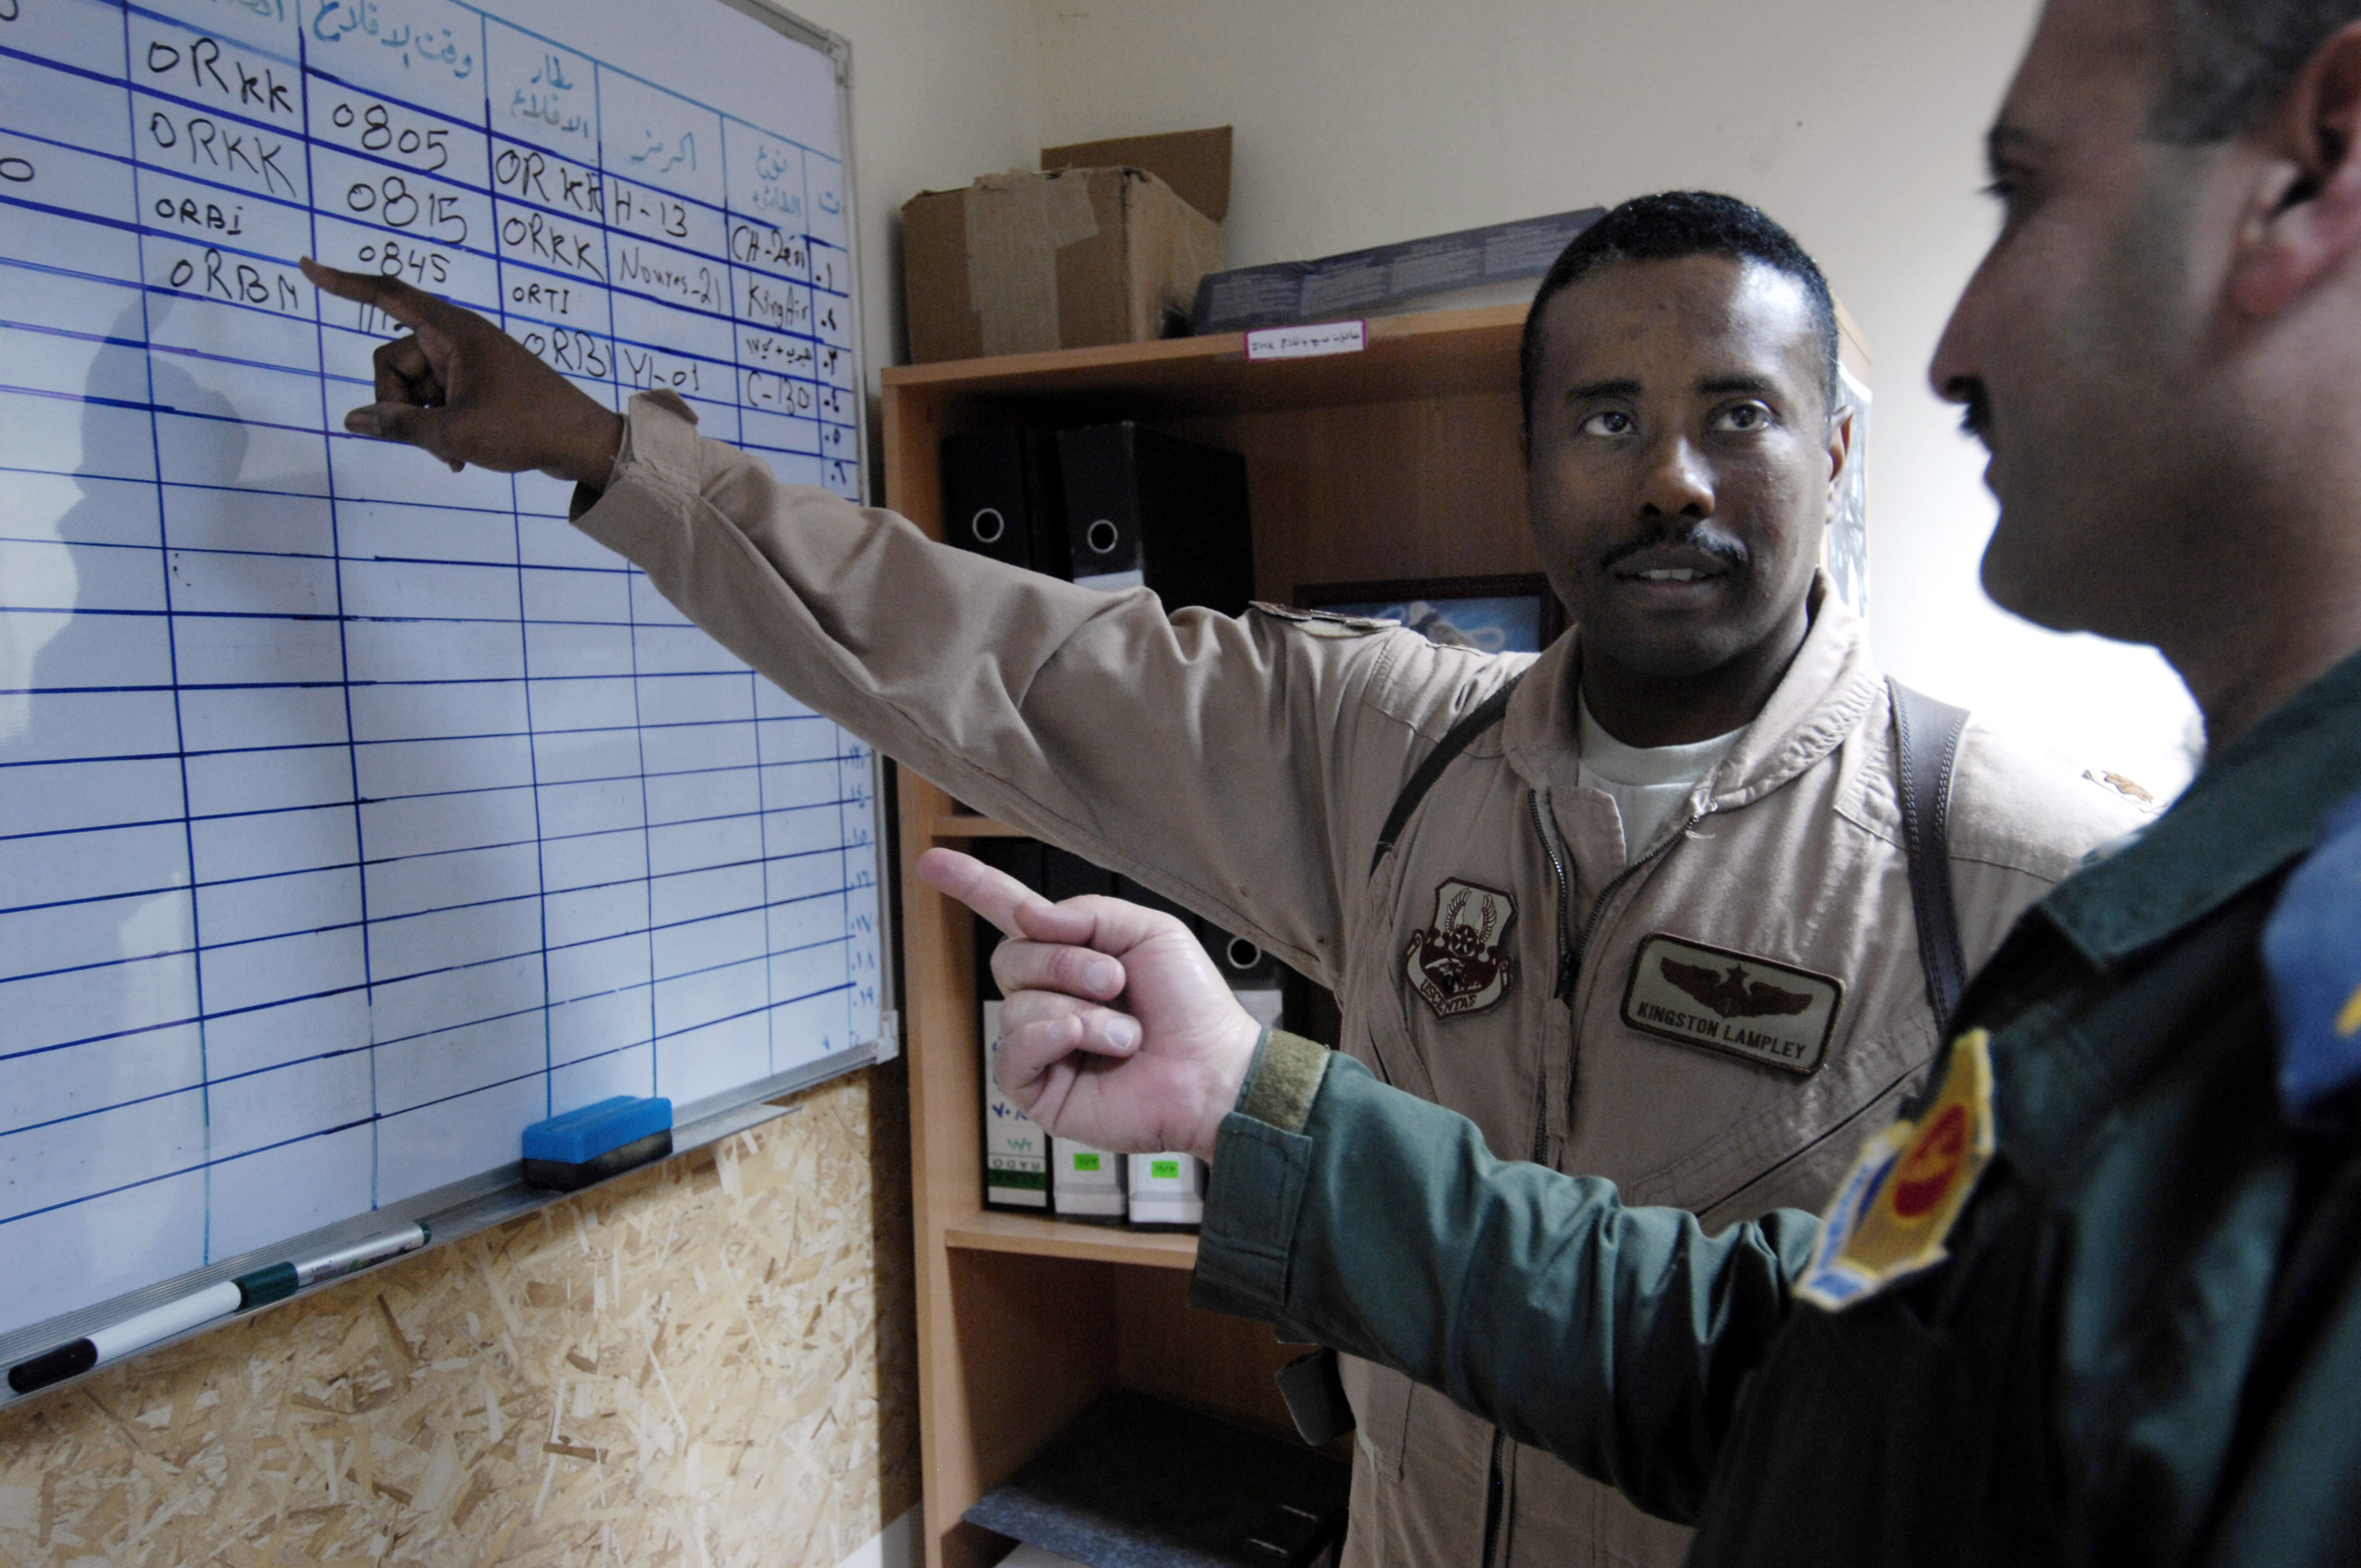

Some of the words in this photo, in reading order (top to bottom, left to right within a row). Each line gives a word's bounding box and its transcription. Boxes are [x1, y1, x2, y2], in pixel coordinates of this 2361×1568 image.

[332, 103, 449, 173] 0805
[347, 175, 467, 245] 0815
[358, 241, 451, 283] 0845
[512, 283, 571, 314] ORTI
[1637, 1001, 1719, 1037] KINGSTON
[1723, 1028, 1806, 1060] LAMPLEY
